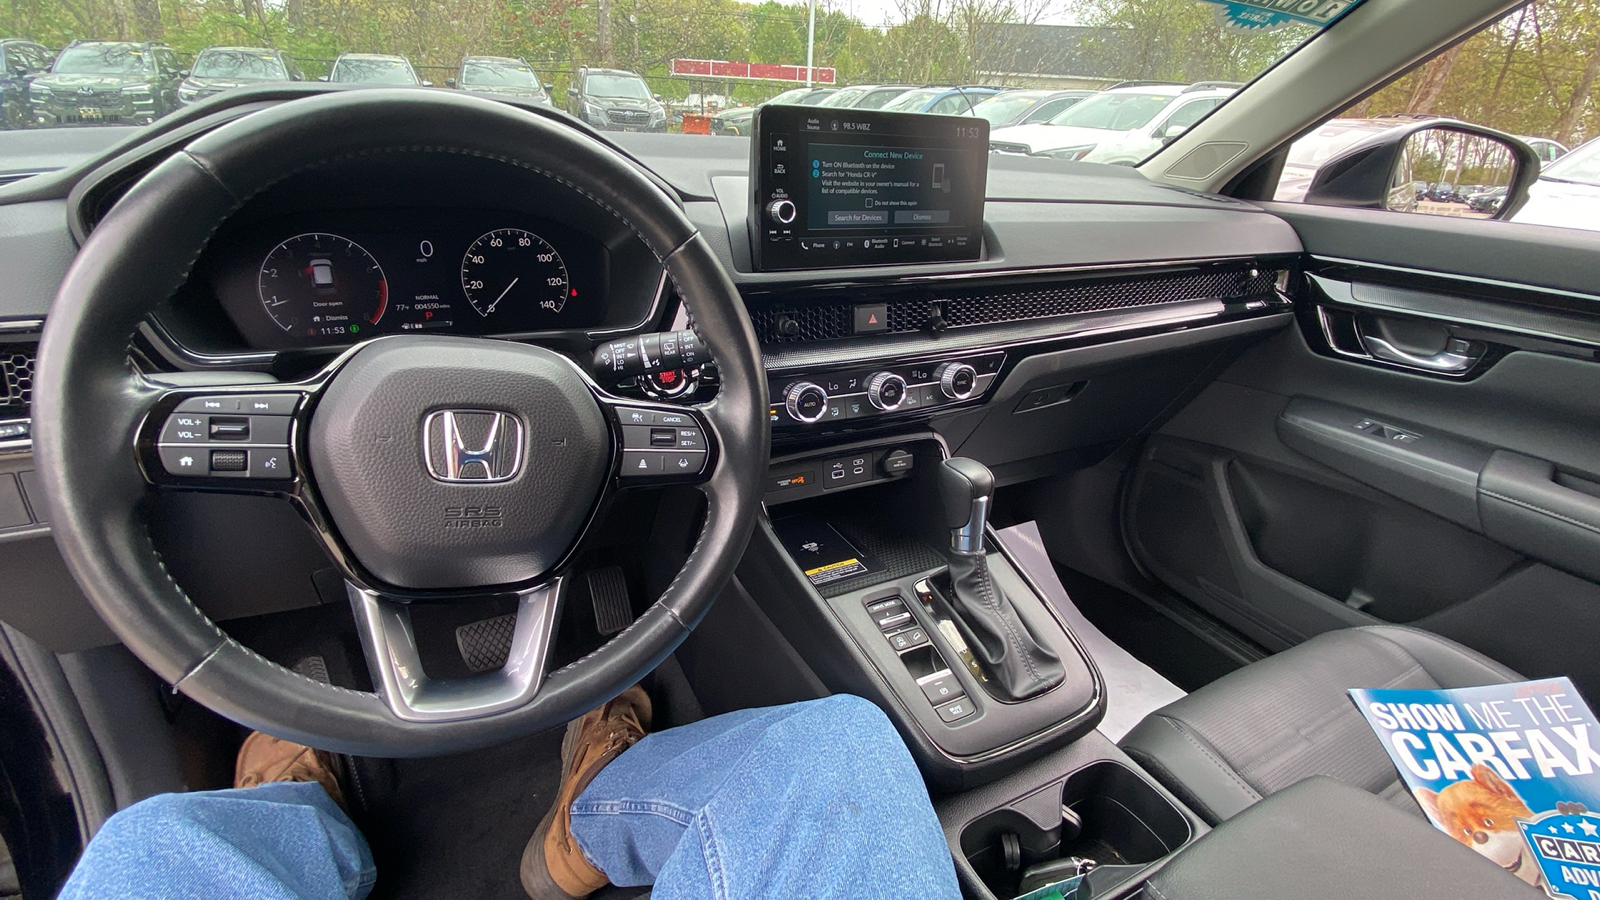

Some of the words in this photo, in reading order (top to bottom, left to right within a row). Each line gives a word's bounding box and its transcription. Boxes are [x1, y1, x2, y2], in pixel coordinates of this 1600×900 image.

[843, 122, 856, 130] 98.5
[956, 127, 979, 138] 11:53
[864, 150, 888, 158] Connect
[904, 151, 923, 159] Device
[490, 238, 503, 247] 60
[518, 237, 531, 246] 80
[420, 240, 434, 257] 0
[471, 255, 485, 264] 40
[537, 254, 552, 262] 100
[270, 268, 278, 277] 2
[470, 280, 483, 289] 20
[546, 277, 562, 286] 120
[414, 302, 439, 310] 004550
[539, 300, 555, 309] 140
[425, 311, 433, 320] P
[320, 326, 345, 335] 11:53
[917, 370, 928, 379] Lo
[828, 382, 839, 390] Lo
[444, 506, 502, 517] SRS
[444, 520, 502, 528] AIRBAG
[1369, 702, 1466, 731] SHOW
[1464, 700, 1521, 730] ME
[1512, 693, 1582, 726] THE
[1391, 723, 1600, 780] CARFAX
[1560, 865, 1600, 888] ADV
